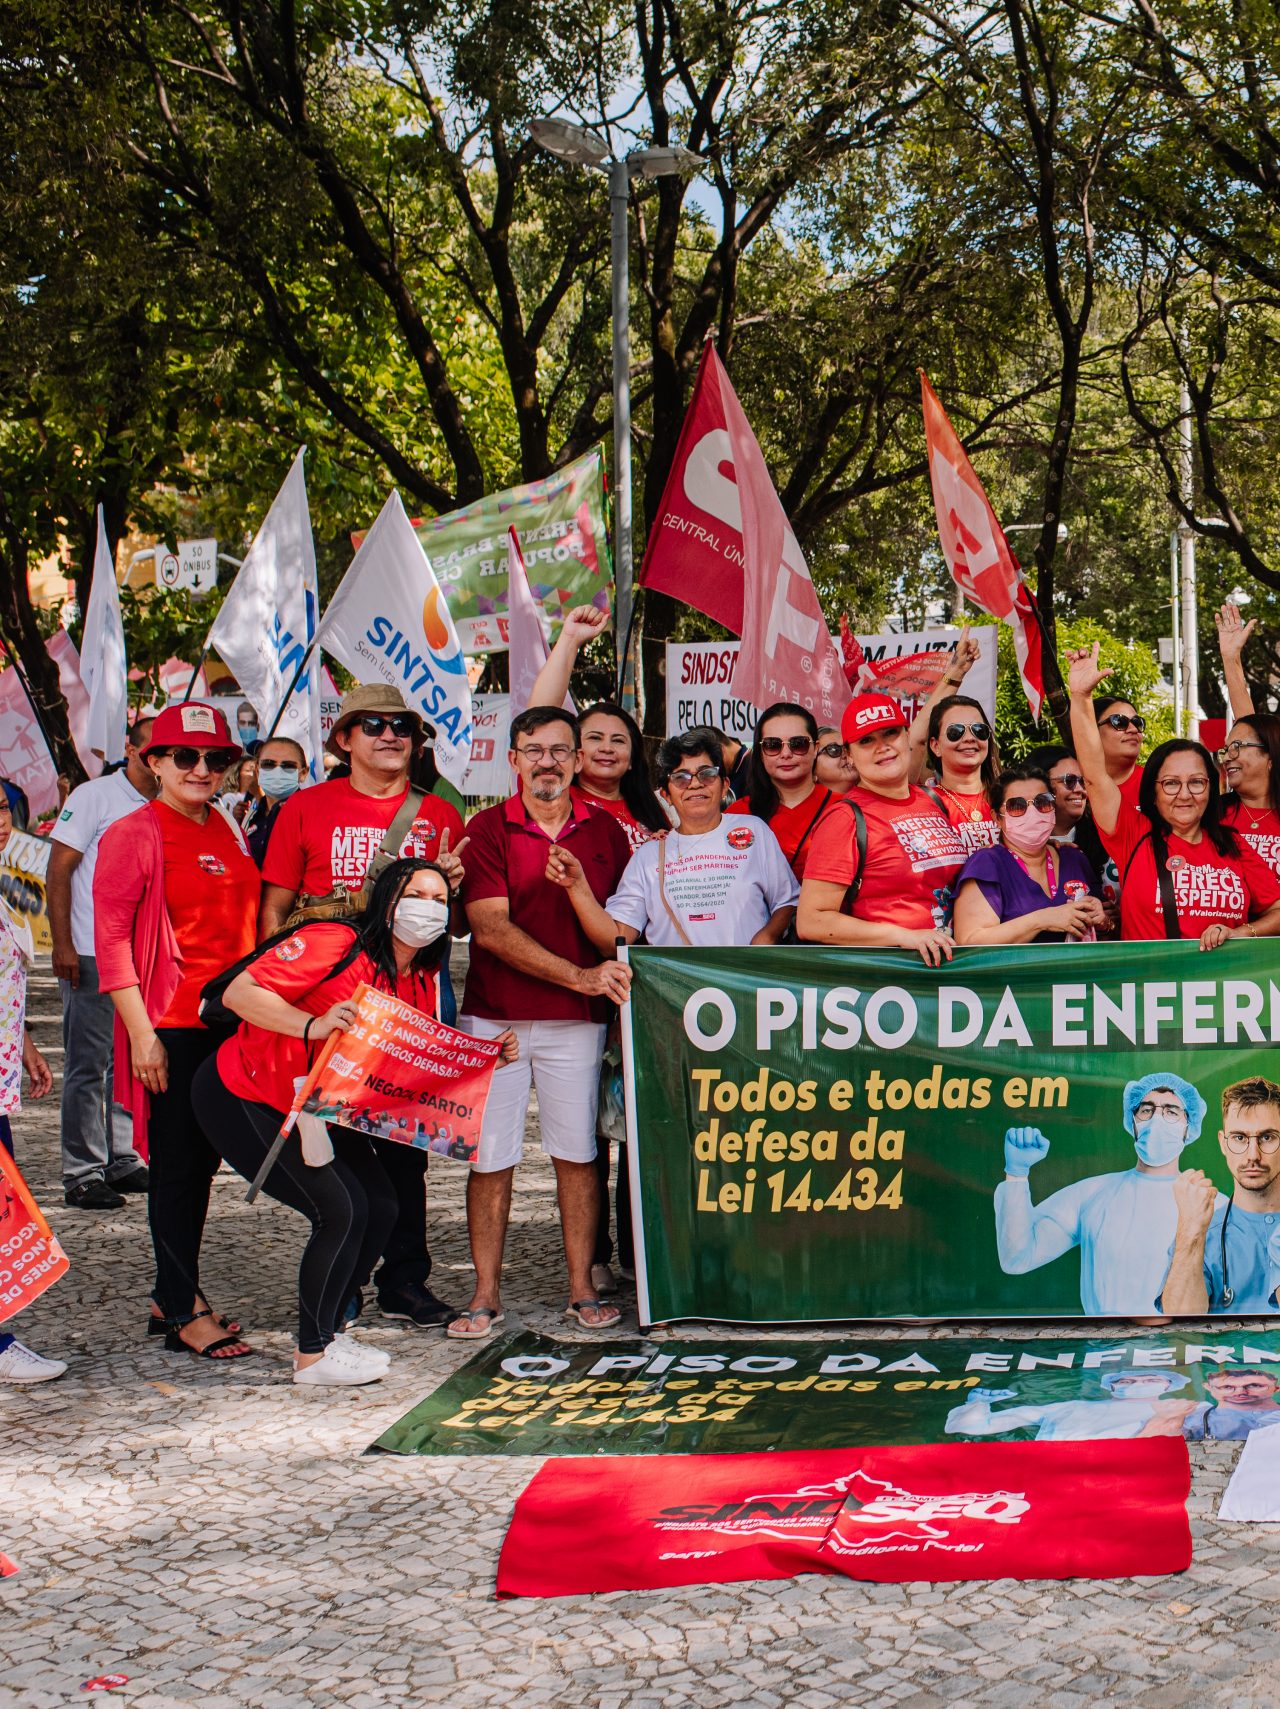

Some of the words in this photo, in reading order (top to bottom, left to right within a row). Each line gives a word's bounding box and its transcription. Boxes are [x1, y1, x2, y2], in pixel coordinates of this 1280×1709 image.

[662, 512, 720, 552] CENTRAL
[183, 559, 212, 573] ÔNIBUS
[354, 640, 380, 665] Sem
[856, 706, 889, 724] CUT
[332, 827, 343, 837] A
[331, 836, 426, 859] MERCE
[358, 1006, 377, 1025] HÁ
[380, 1018, 393, 1033] 15
[394, 1027, 426, 1050] ANOS
[364, 991, 437, 1035] SERVIDORES
[436, 1028, 456, 1044] DE
[683, 987, 736, 1052] O
[756, 986, 918, 1051] PISO
[938, 985, 1033, 1048] DA
[348, 1023, 367, 1040] DE
[368, 1033, 416, 1064] CARGOS
[691, 1067, 818, 1112] Todos
[829, 1080, 853, 1111] e
[865, 1065, 991, 1110] todas
[1003, 1075, 1069, 1108] em
[418, 1091, 473, 1120] SARTO!
[694, 1119, 838, 1163] defesa
[850, 1117, 905, 1161] da
[696, 1167, 756, 1213] Lei
[767, 1167, 904, 1213] 14.434
[500, 1355, 570, 1377] O
[587, 1354, 798, 1376] PISO
[819, 1352, 940, 1374] DA
[488, 1378, 662, 1397] Todos
[664, 1377, 697, 1393] e
[715, 1374, 883, 1393] todas
[894, 1376, 981, 1392] em
[461, 1390, 666, 1412] defesa
[677, 1388, 758, 1408] da
[441, 1408, 533, 1428] Lei
[548, 1404, 751, 1427] 14.434
